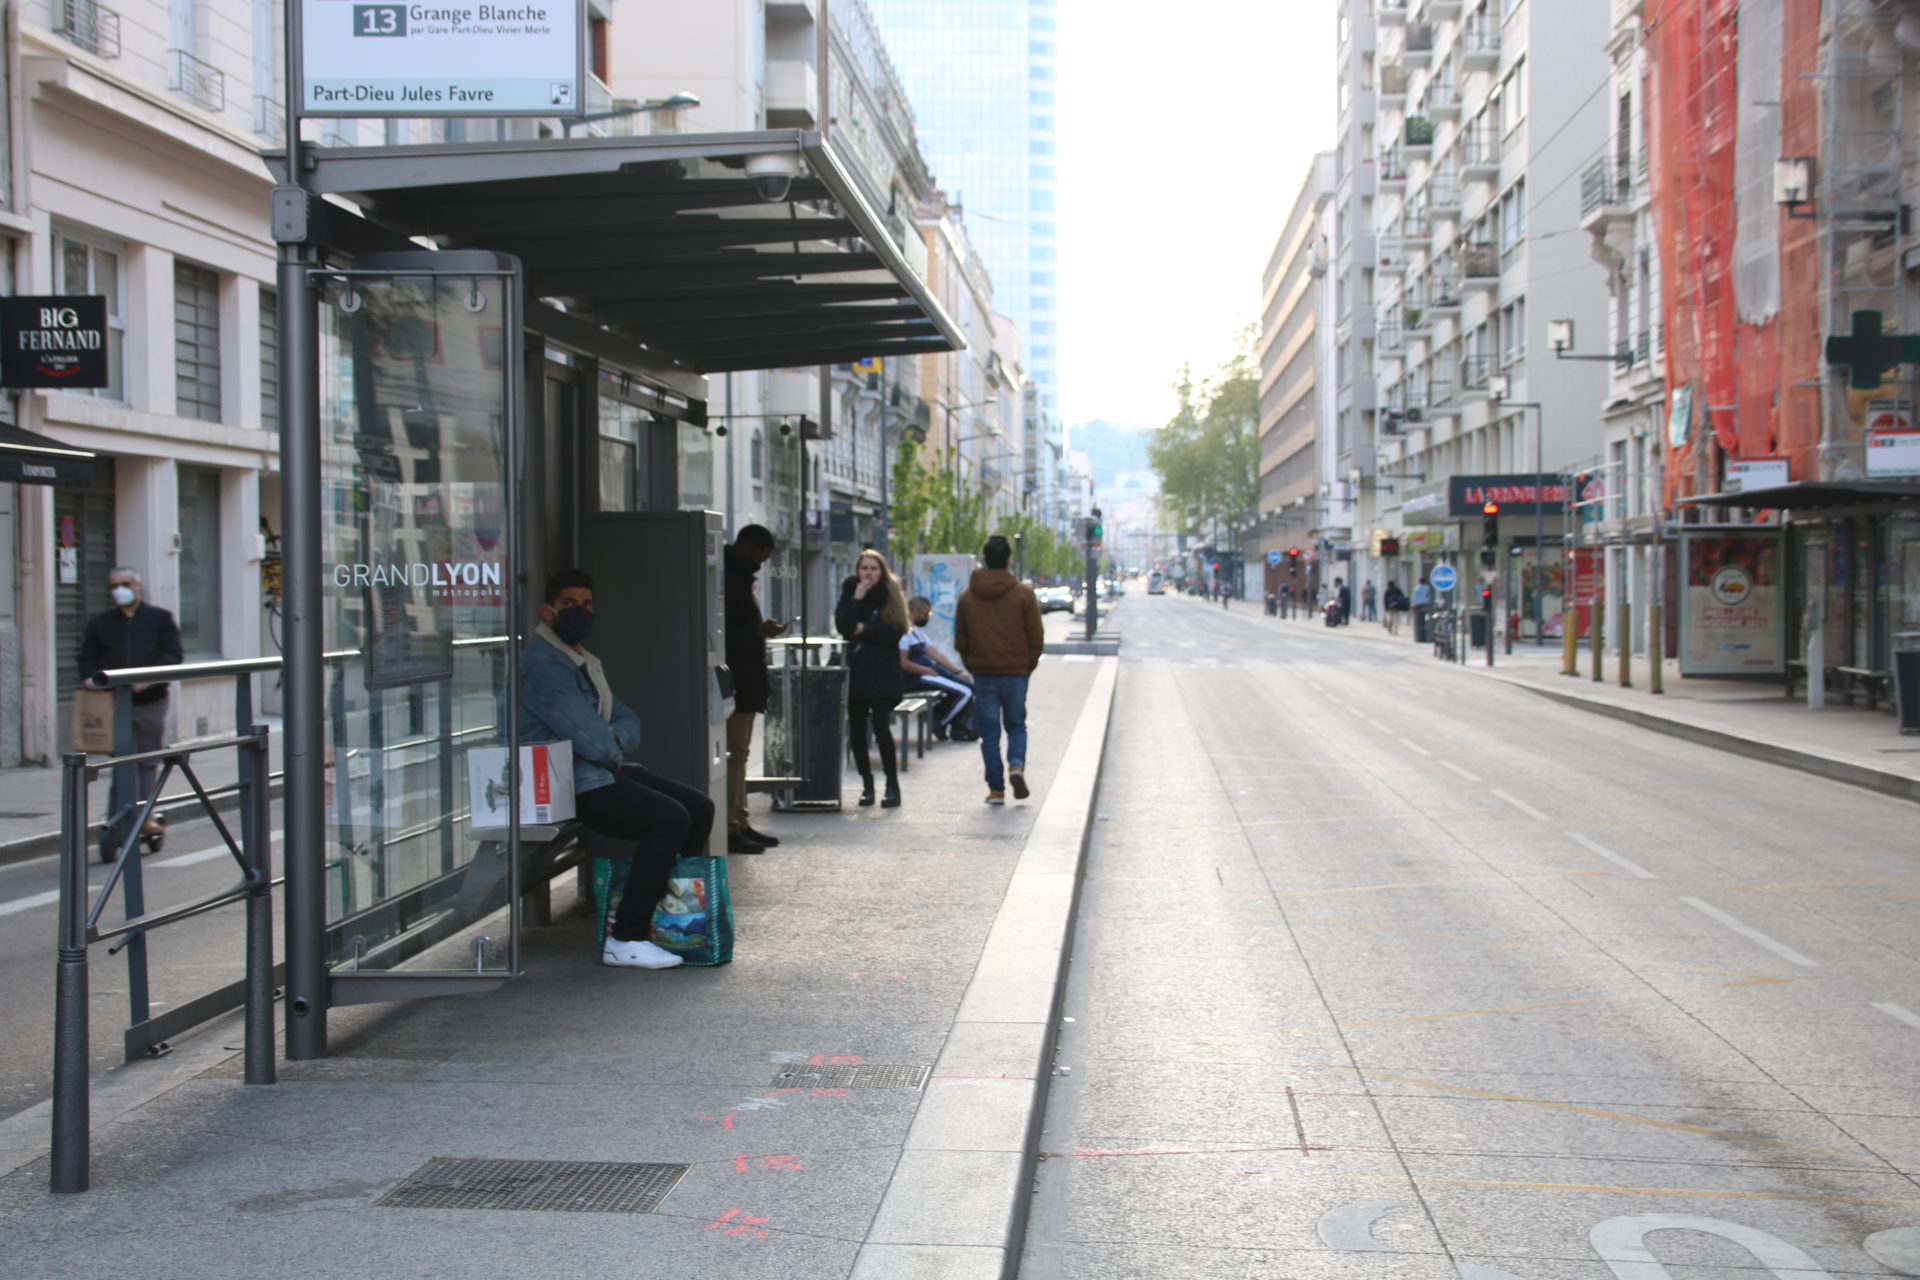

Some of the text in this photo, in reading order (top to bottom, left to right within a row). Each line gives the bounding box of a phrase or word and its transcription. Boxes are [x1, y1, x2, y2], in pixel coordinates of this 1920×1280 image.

[362, 8, 398, 34] 13
[410, 5, 547, 25] Grange Blanche
[410, 25, 551, 36] par Gare Part-Dieu Vivier Merle
[313, 85, 495, 101] Part-Dieu Jules Favre
[40, 307, 79, 329] BIG
[19, 329, 101, 351] FERNAND
[1464, 487, 1484, 503] LA
